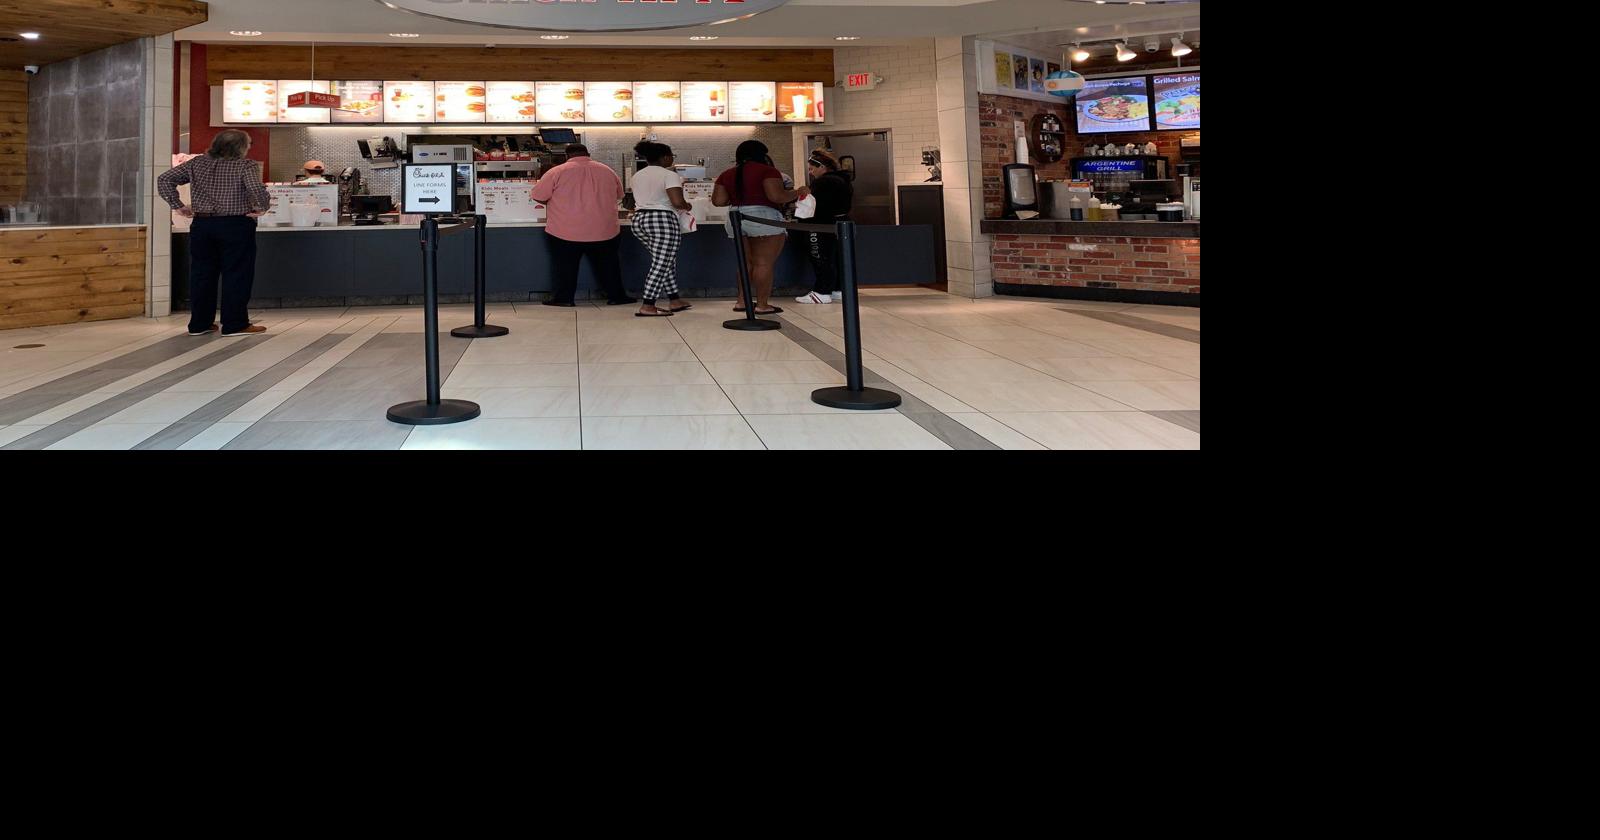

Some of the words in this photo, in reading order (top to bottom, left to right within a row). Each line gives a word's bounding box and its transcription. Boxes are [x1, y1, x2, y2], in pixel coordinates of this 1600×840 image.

[848, 73, 869, 87] EXIT
[1153, 76, 1181, 84] Grilled
[314, 93, 326, 101] Pick
[327, 95, 335, 103] Up
